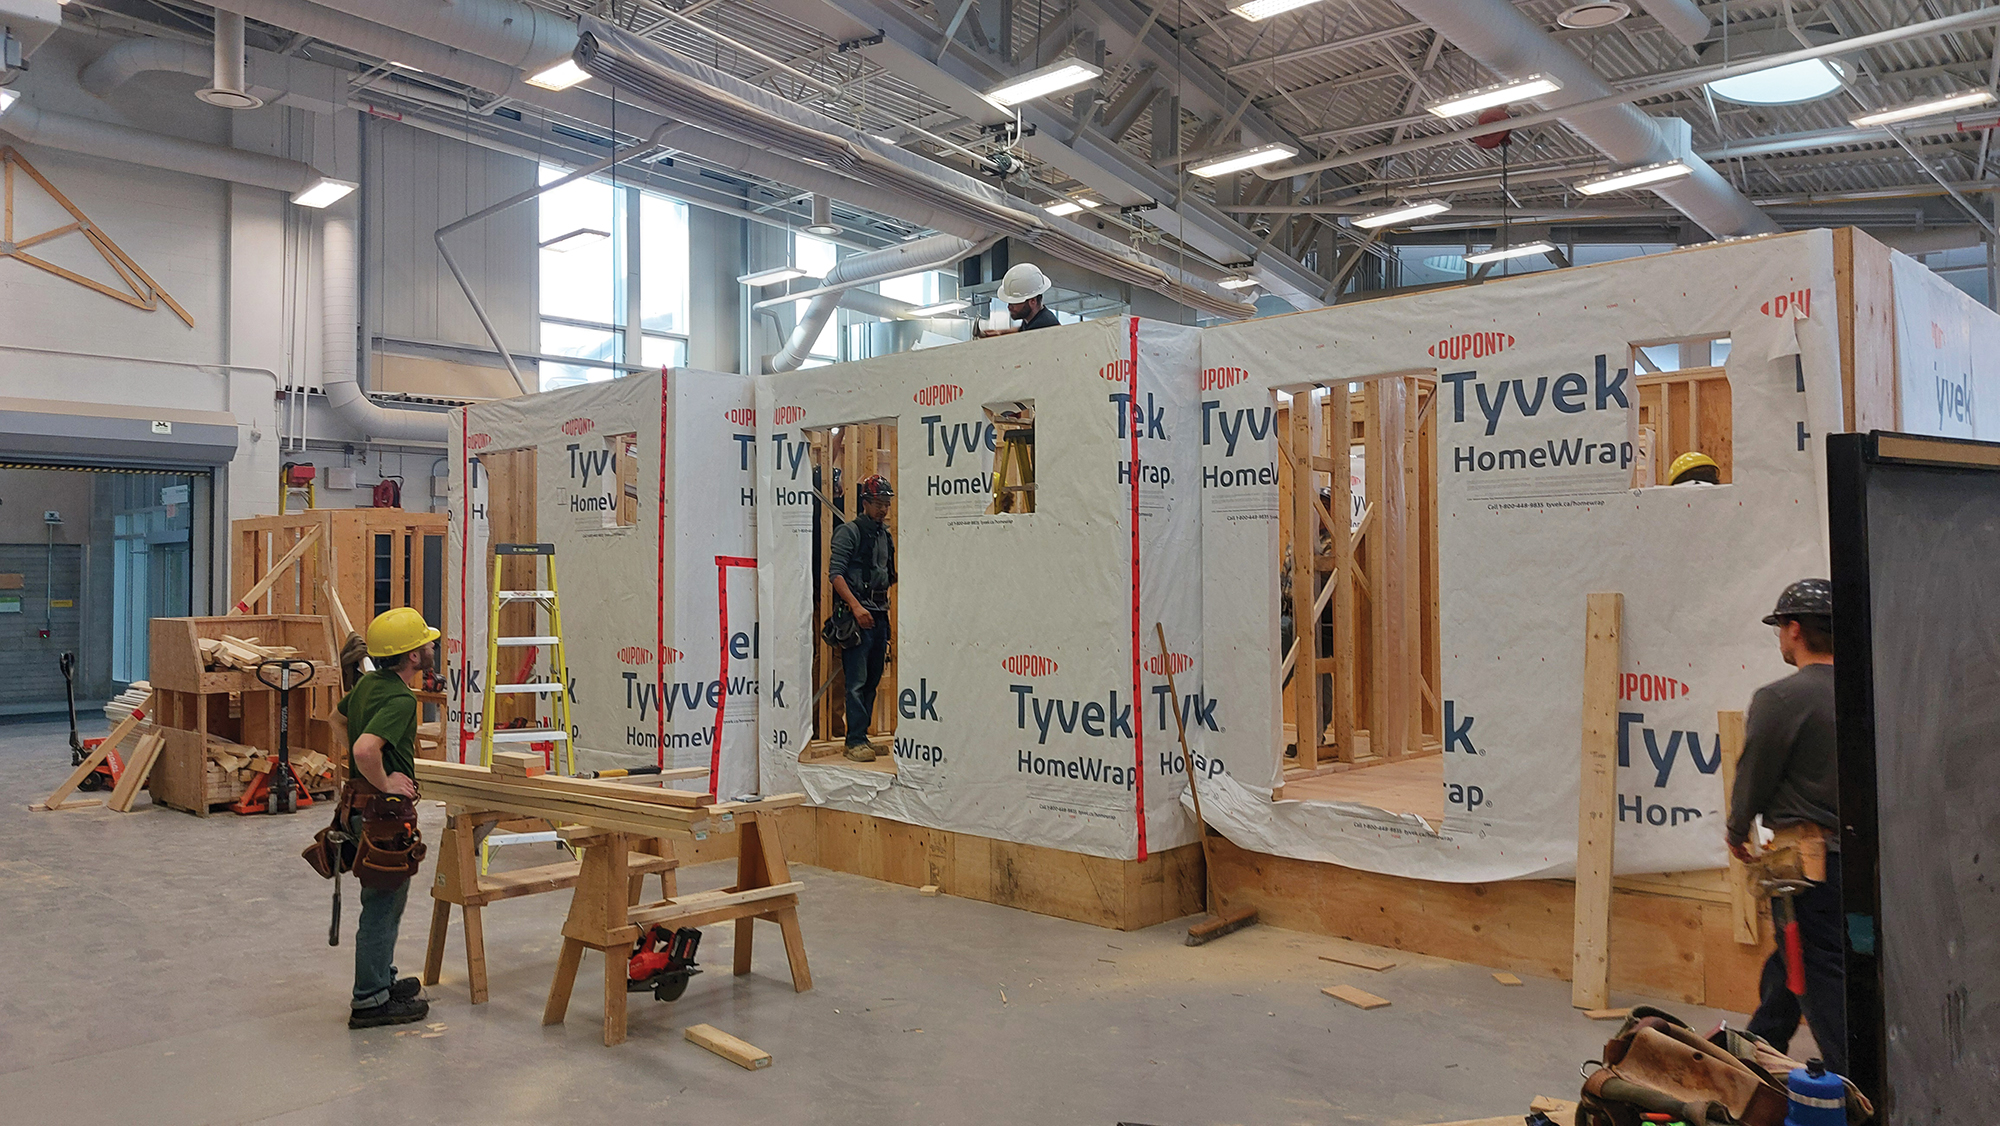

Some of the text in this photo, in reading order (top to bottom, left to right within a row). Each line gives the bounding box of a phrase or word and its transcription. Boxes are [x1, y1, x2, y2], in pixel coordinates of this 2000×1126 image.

[1440, 332, 1505, 361] DUPONT
[919, 384, 958, 407] DUPONT
[1441, 354, 1630, 437] Tyvek
[565, 417, 592, 437] DUPONT
[771, 432, 811, 481] Ty
[1454, 437, 1633, 473] HomeWrap
[620, 646, 650, 666] DUPONT
[1008, 654, 1052, 678] DUPONT
[1009, 684, 1134, 745] Tyvek
[1018, 749, 1136, 792] HomeWrap
